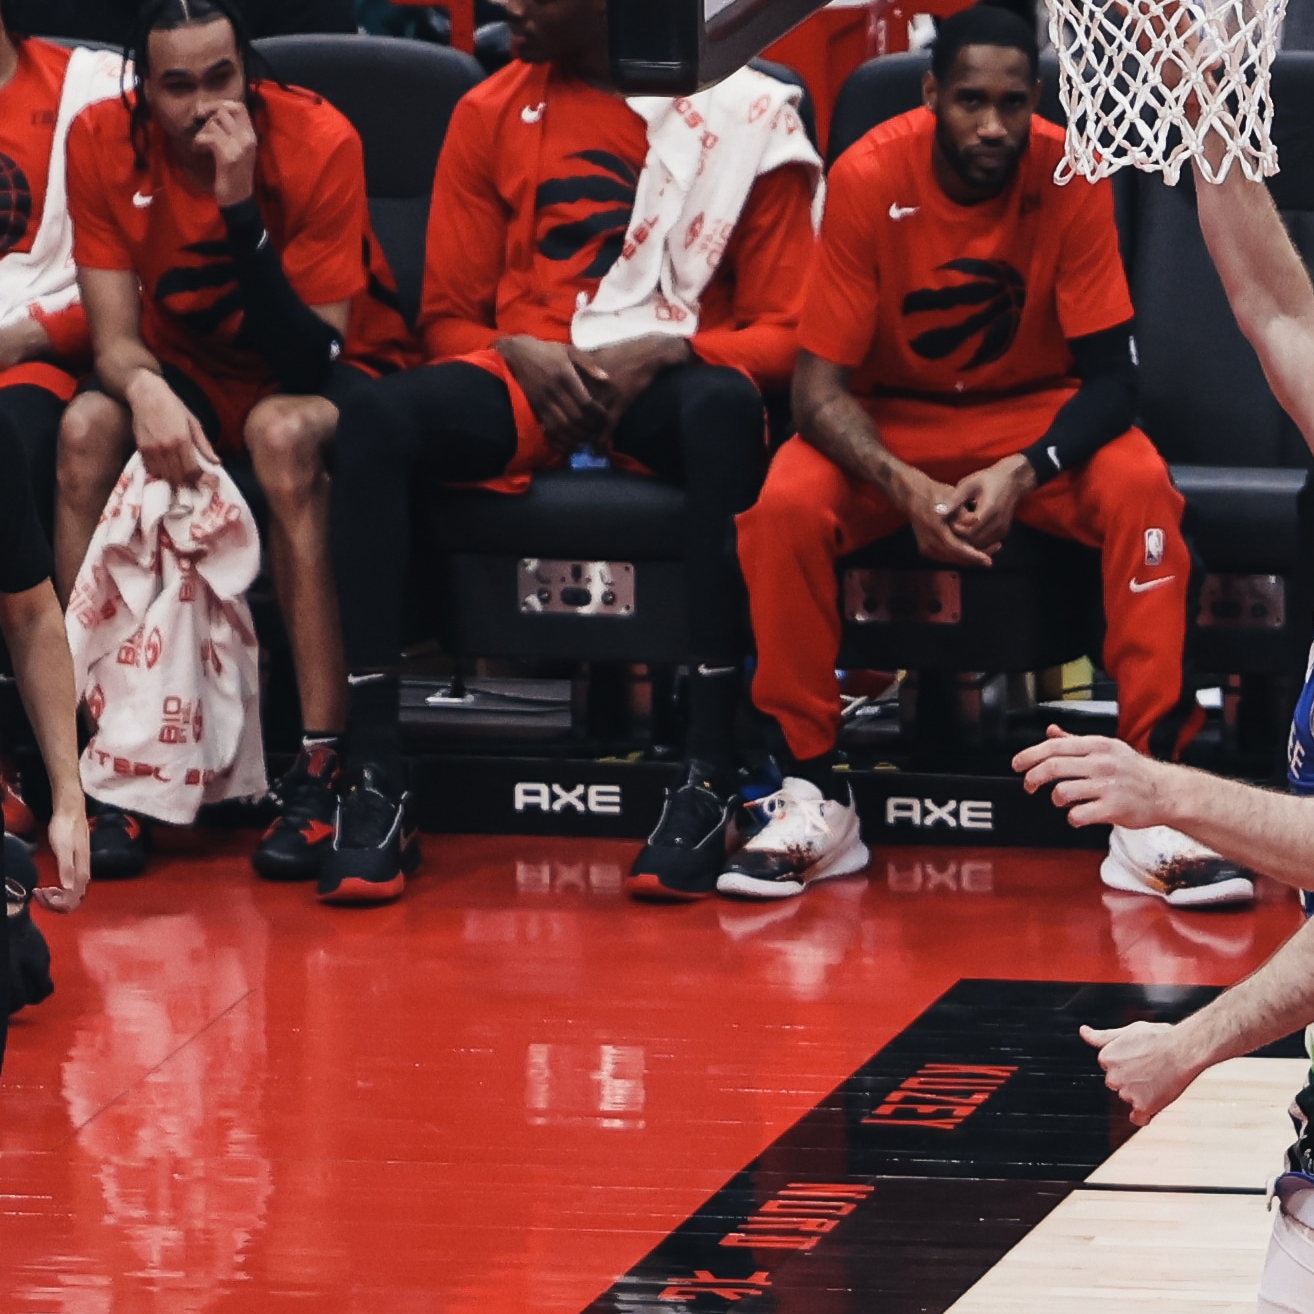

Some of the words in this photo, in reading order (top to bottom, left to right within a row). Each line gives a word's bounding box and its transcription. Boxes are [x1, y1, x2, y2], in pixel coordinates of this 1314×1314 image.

[514, 781, 621, 814] AXE
[886, 796, 994, 830] AXE
[860, 1063, 1019, 1131] KUZEY
[718, 1182, 875, 1251] NORD
